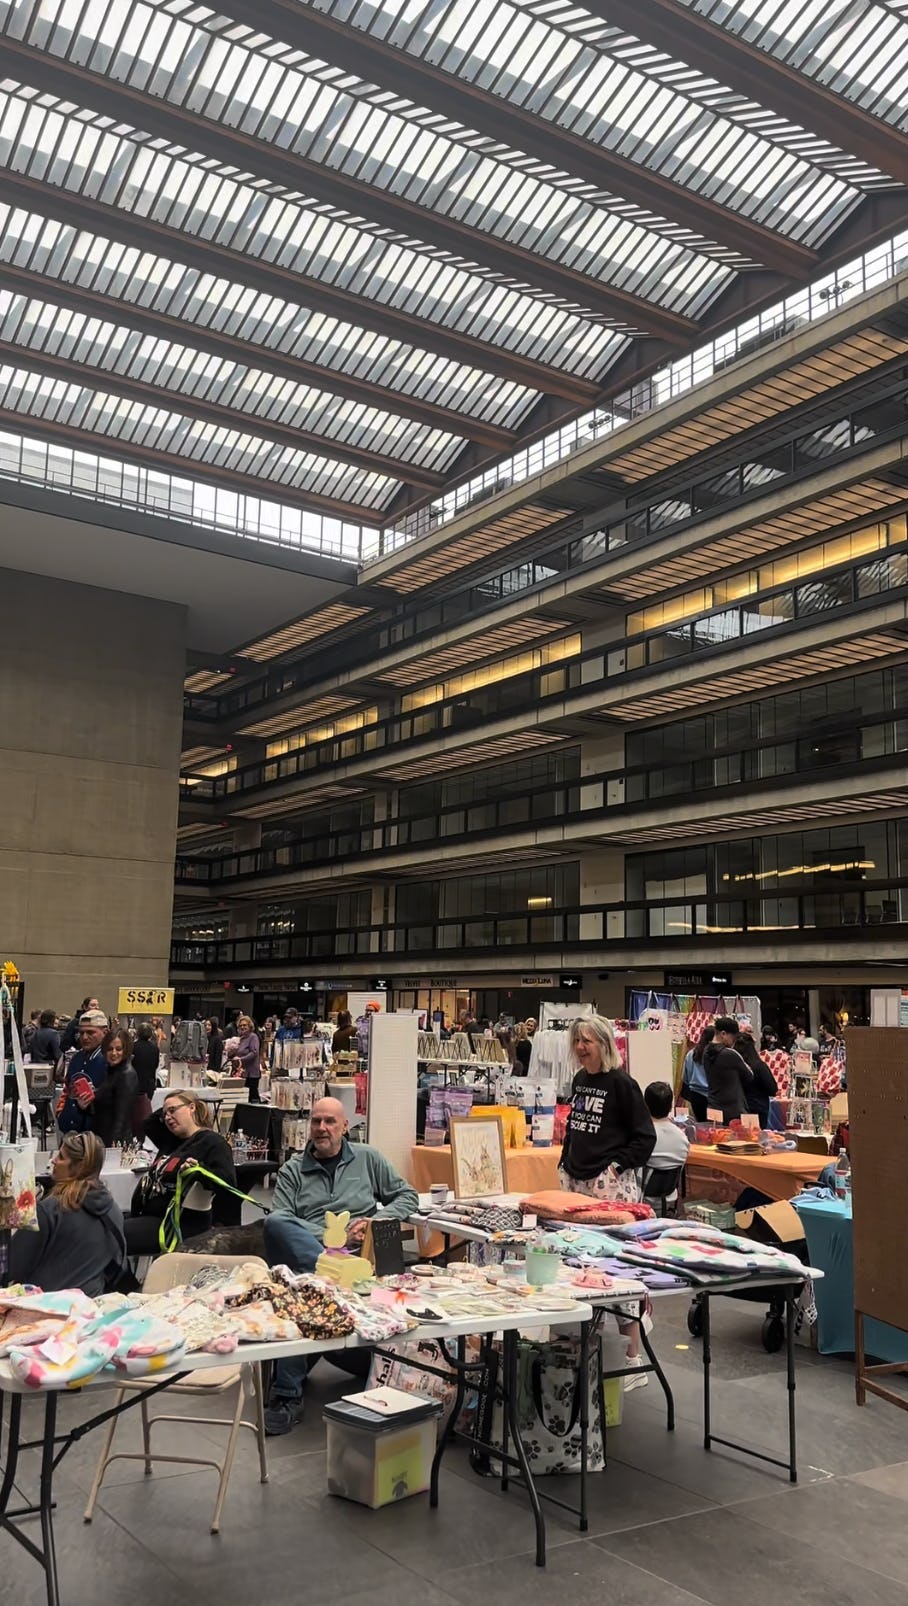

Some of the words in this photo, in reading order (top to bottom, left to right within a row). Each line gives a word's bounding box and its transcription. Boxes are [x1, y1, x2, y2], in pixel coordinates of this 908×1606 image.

[586, 1115, 602, 1123] CAN
[571, 1120, 587, 1131] SCUE
[588, 1123, 600, 1134] IT
